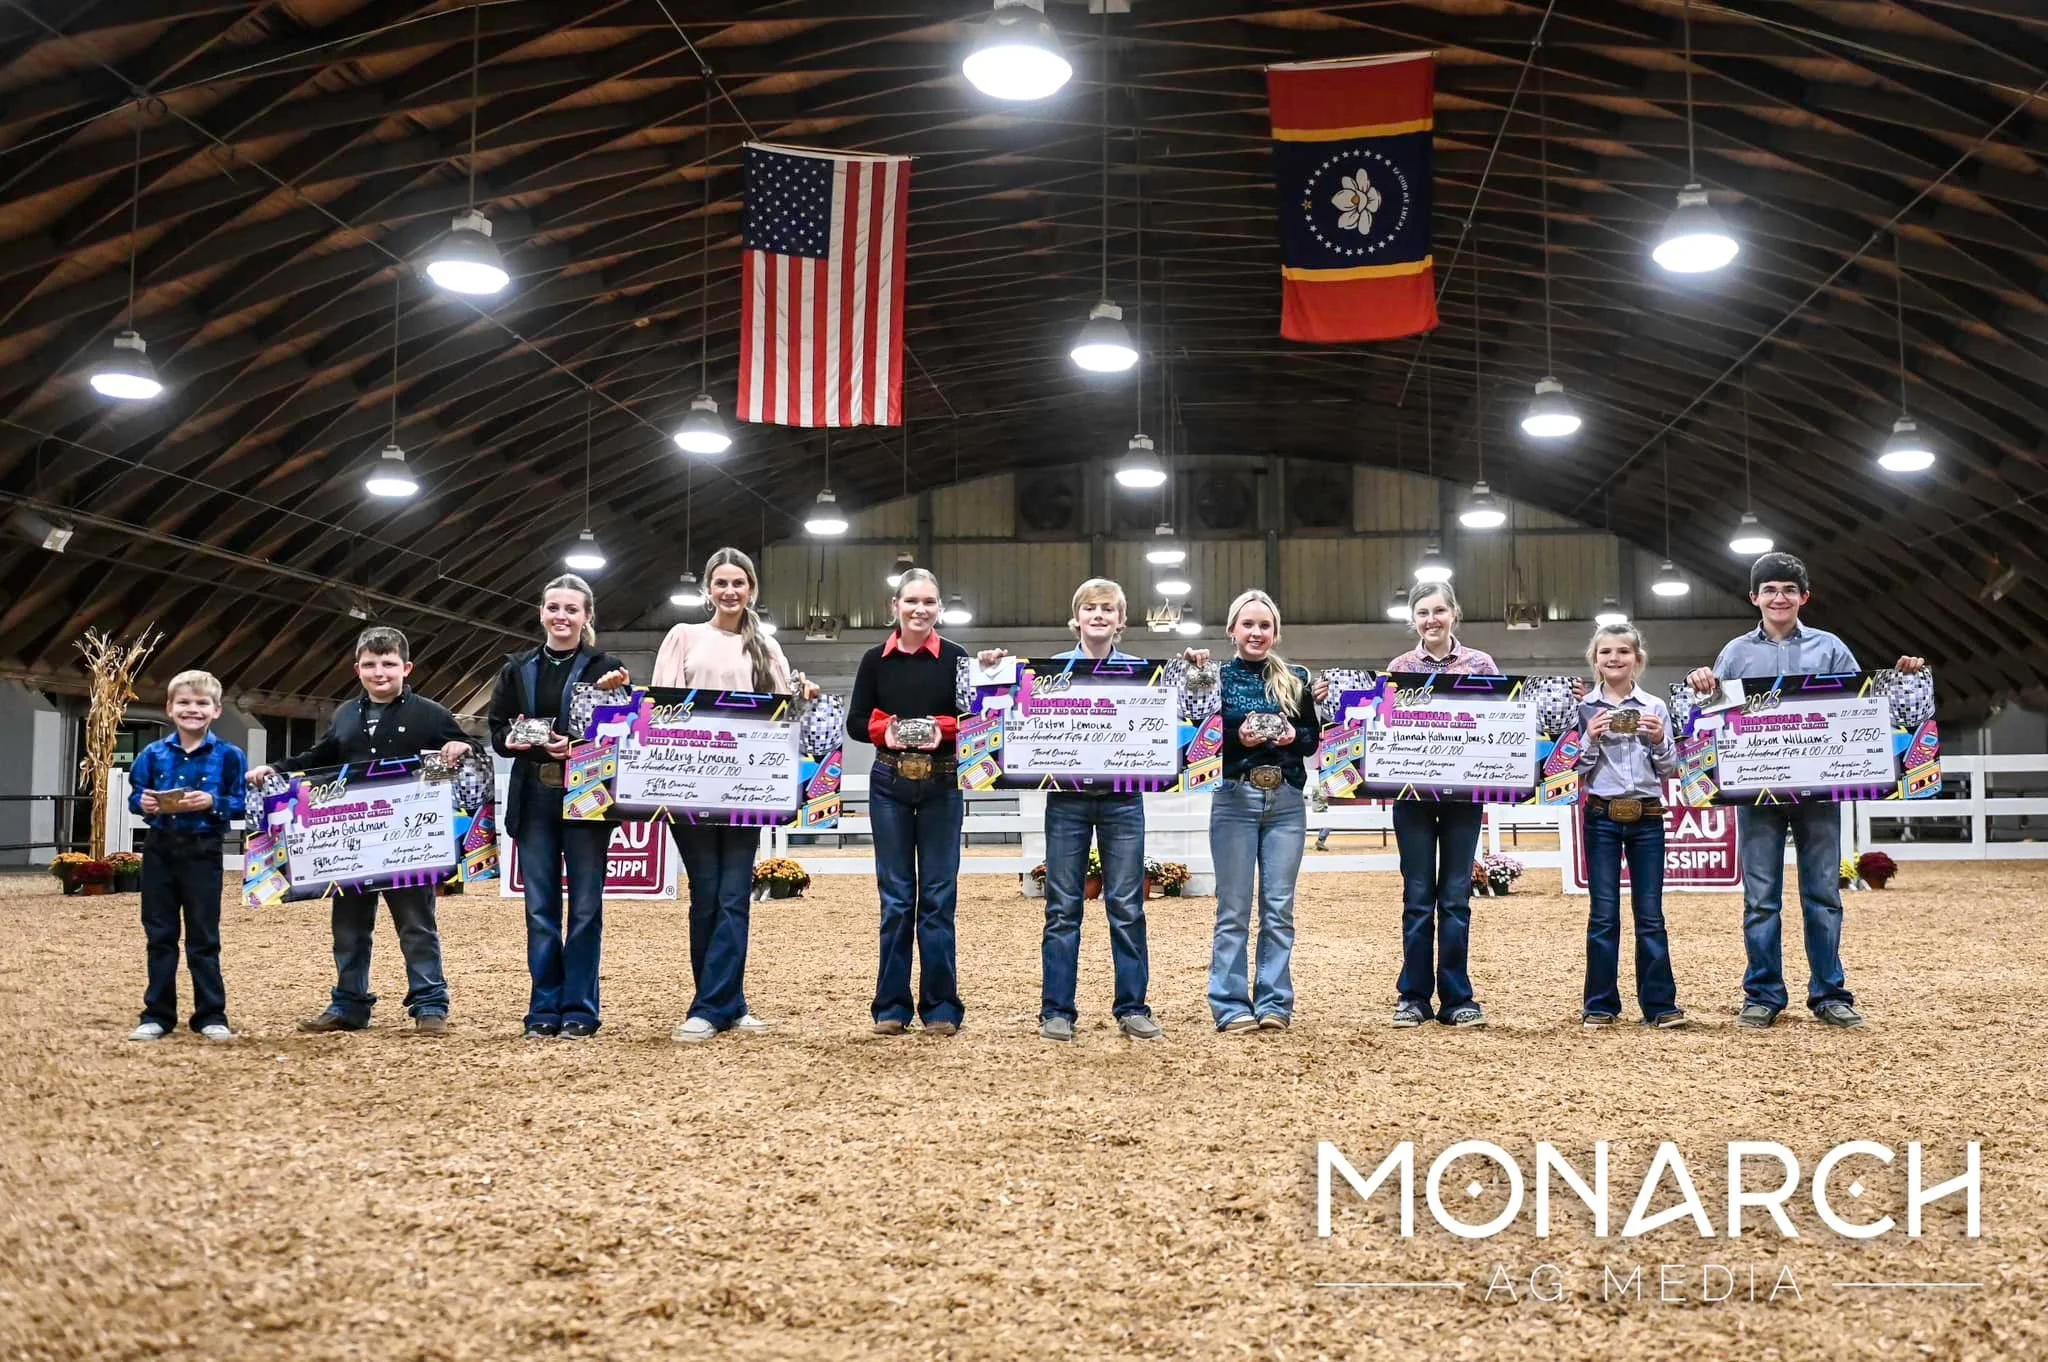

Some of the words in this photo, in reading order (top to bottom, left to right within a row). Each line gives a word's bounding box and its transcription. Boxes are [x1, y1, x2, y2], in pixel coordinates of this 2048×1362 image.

[1026, 717, 1065, 730] Paxton
[1393, 731, 1426, 742] Hannah
[1782, 733, 1832, 745] Williams
[341, 821, 389, 836] Goldman
